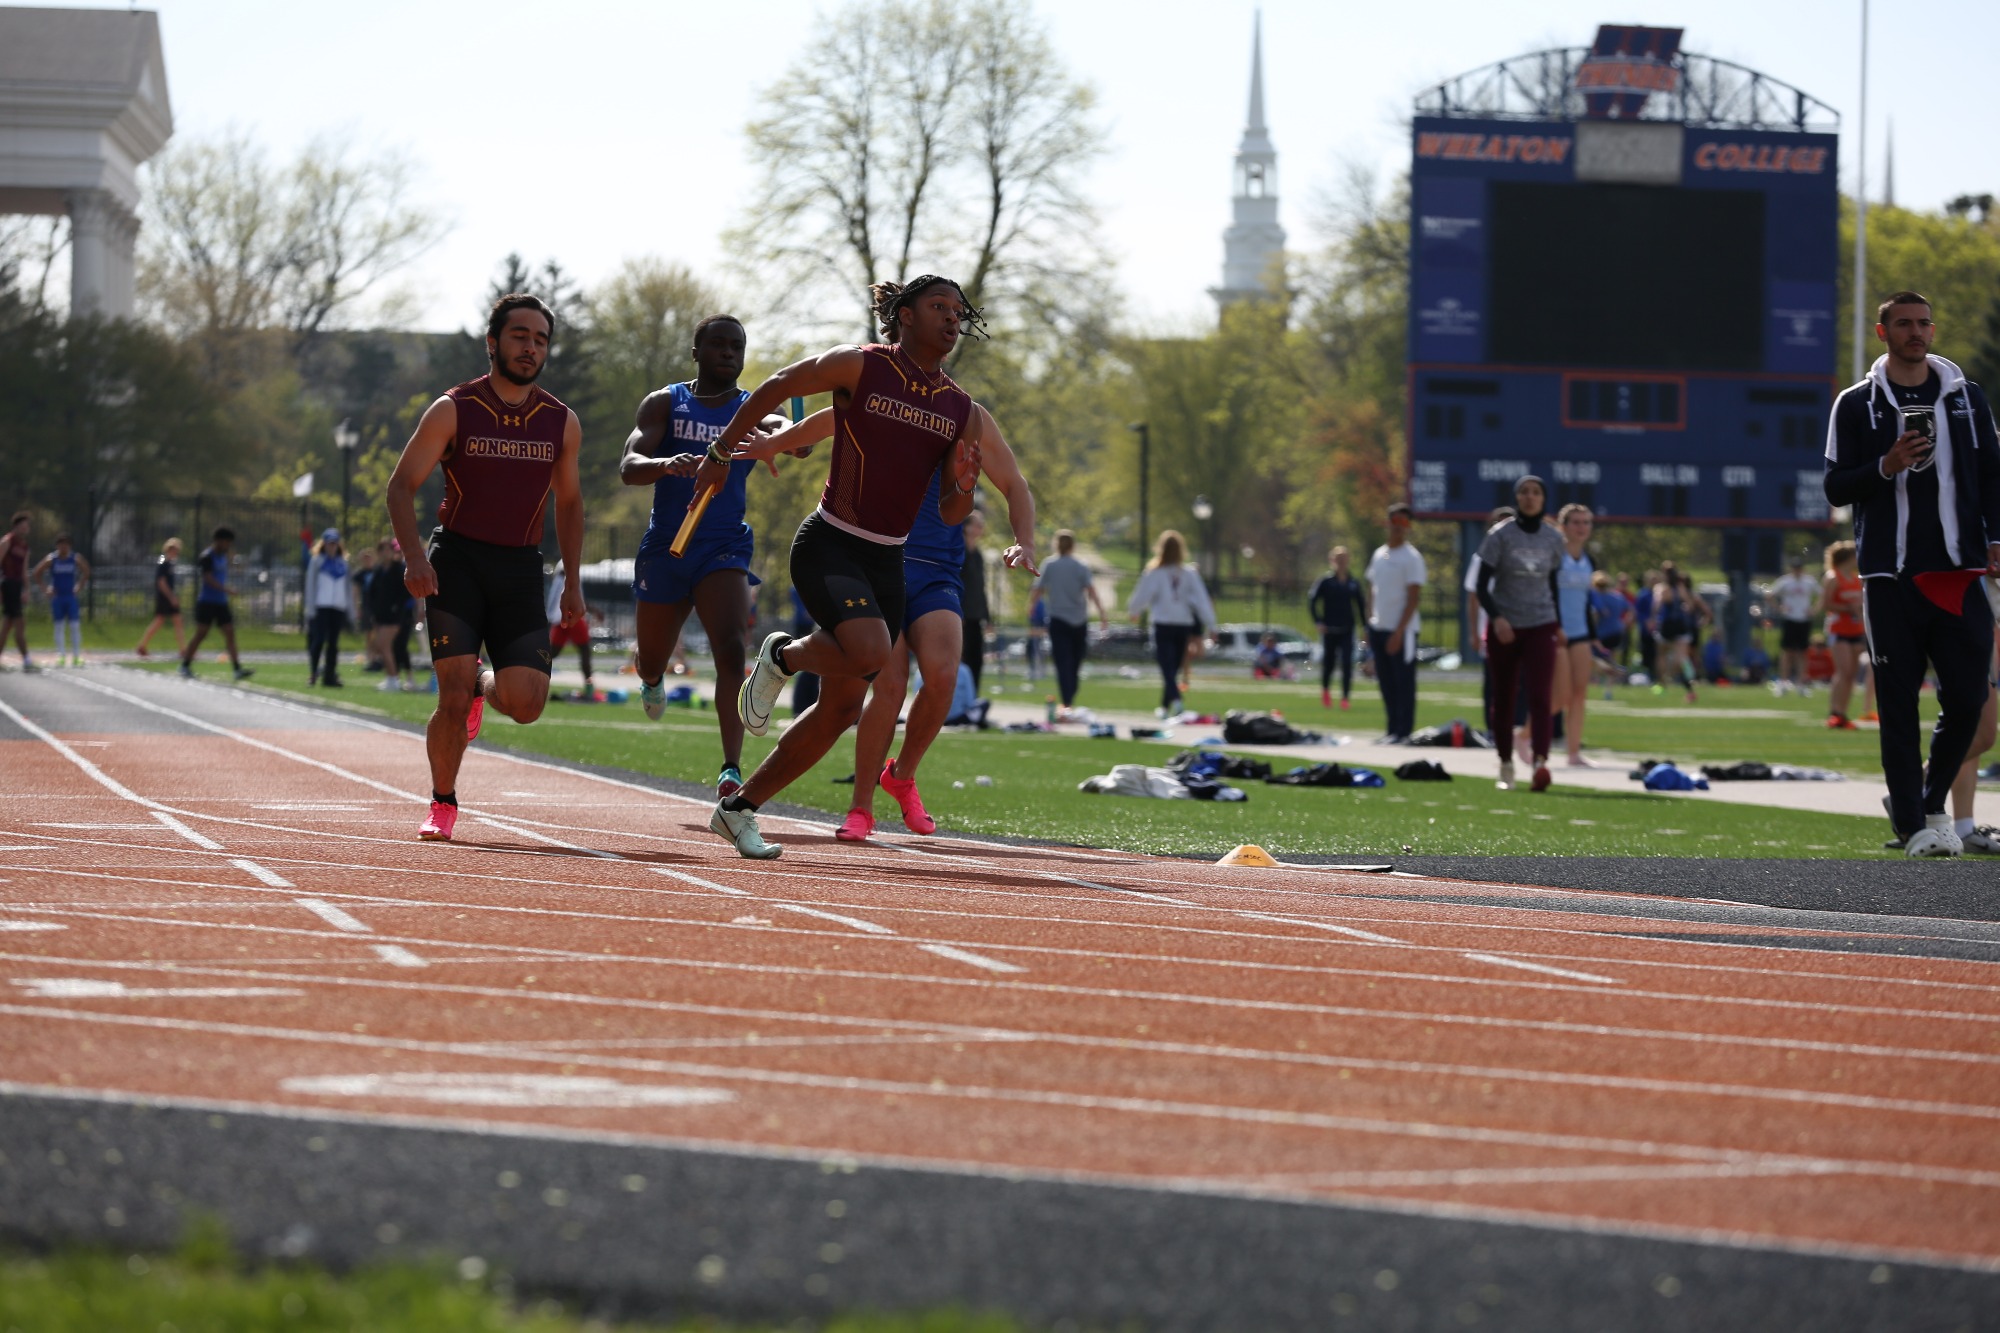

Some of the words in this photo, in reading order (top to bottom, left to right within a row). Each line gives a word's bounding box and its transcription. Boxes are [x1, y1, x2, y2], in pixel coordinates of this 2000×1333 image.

[1417, 131, 1571, 164] WHEATON
[1695, 142, 1828, 174] COLLEGE
[864, 393, 957, 441] CONCORDIA
[466, 436, 553, 462] CONCORDIA
[1478, 459, 1531, 481] DOWN
[1552, 461, 1574, 483] TO
[1576, 462, 1600, 484] GO
